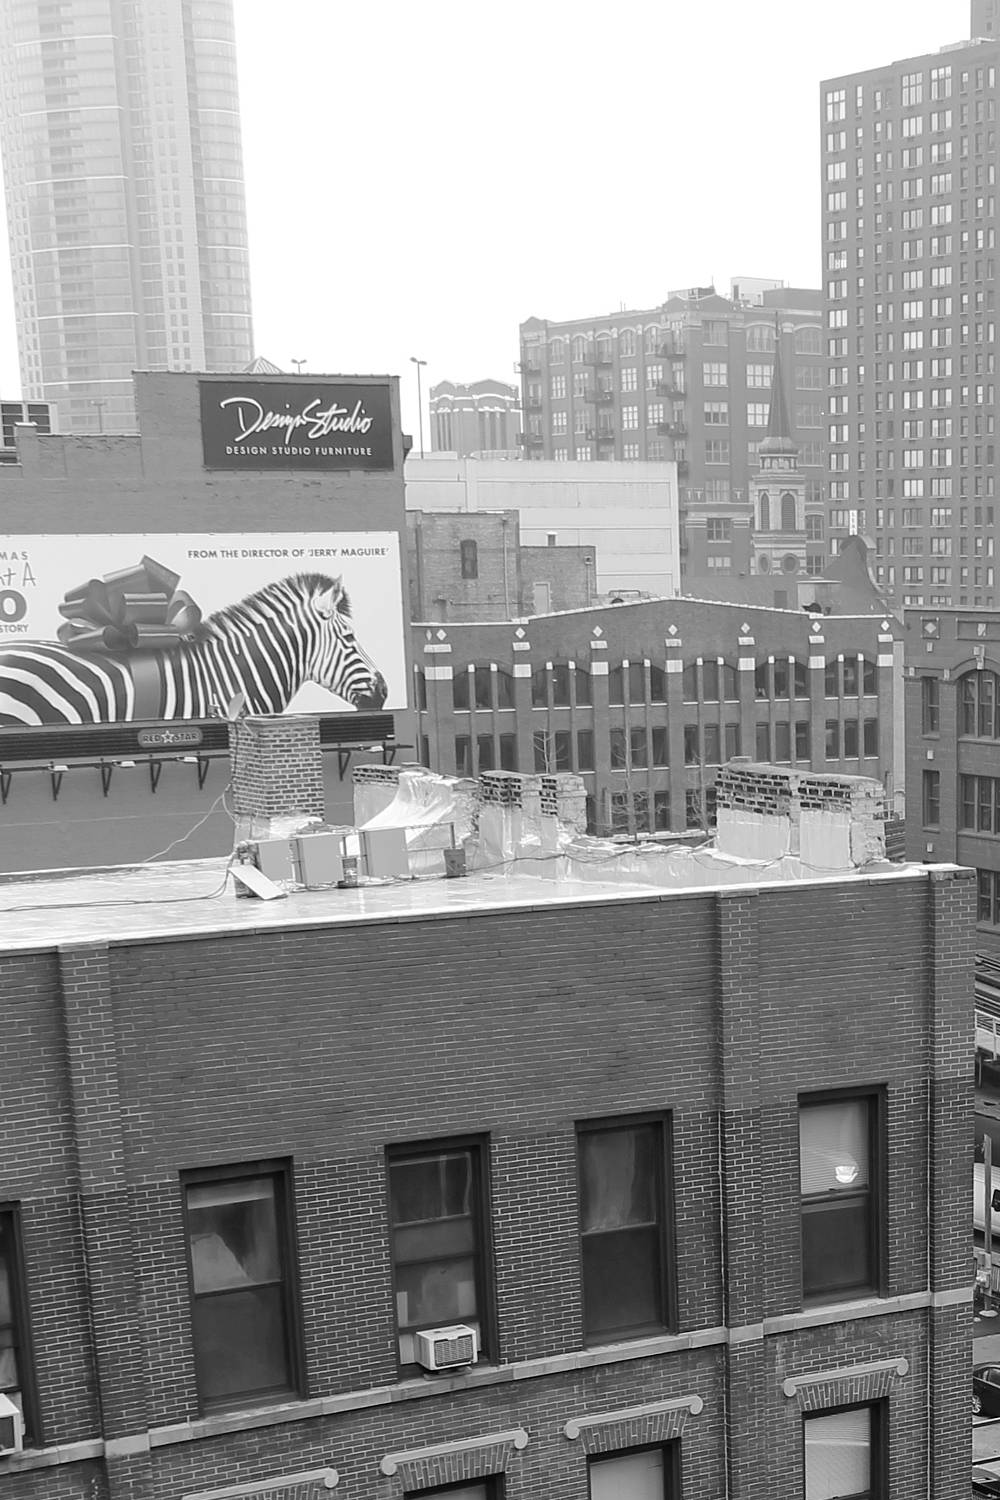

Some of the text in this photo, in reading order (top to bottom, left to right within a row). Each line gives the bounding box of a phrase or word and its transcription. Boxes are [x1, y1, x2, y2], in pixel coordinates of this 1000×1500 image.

[226, 446, 373, 456] DESIGN STUDIO FURNITURE
[188, 550, 218, 558] FROM
[220, 549, 239, 558] THE
[241, 549, 289, 558] DIRECTOR
[292, 549, 305, 557] OF
[23, 562, 36, 586] A
